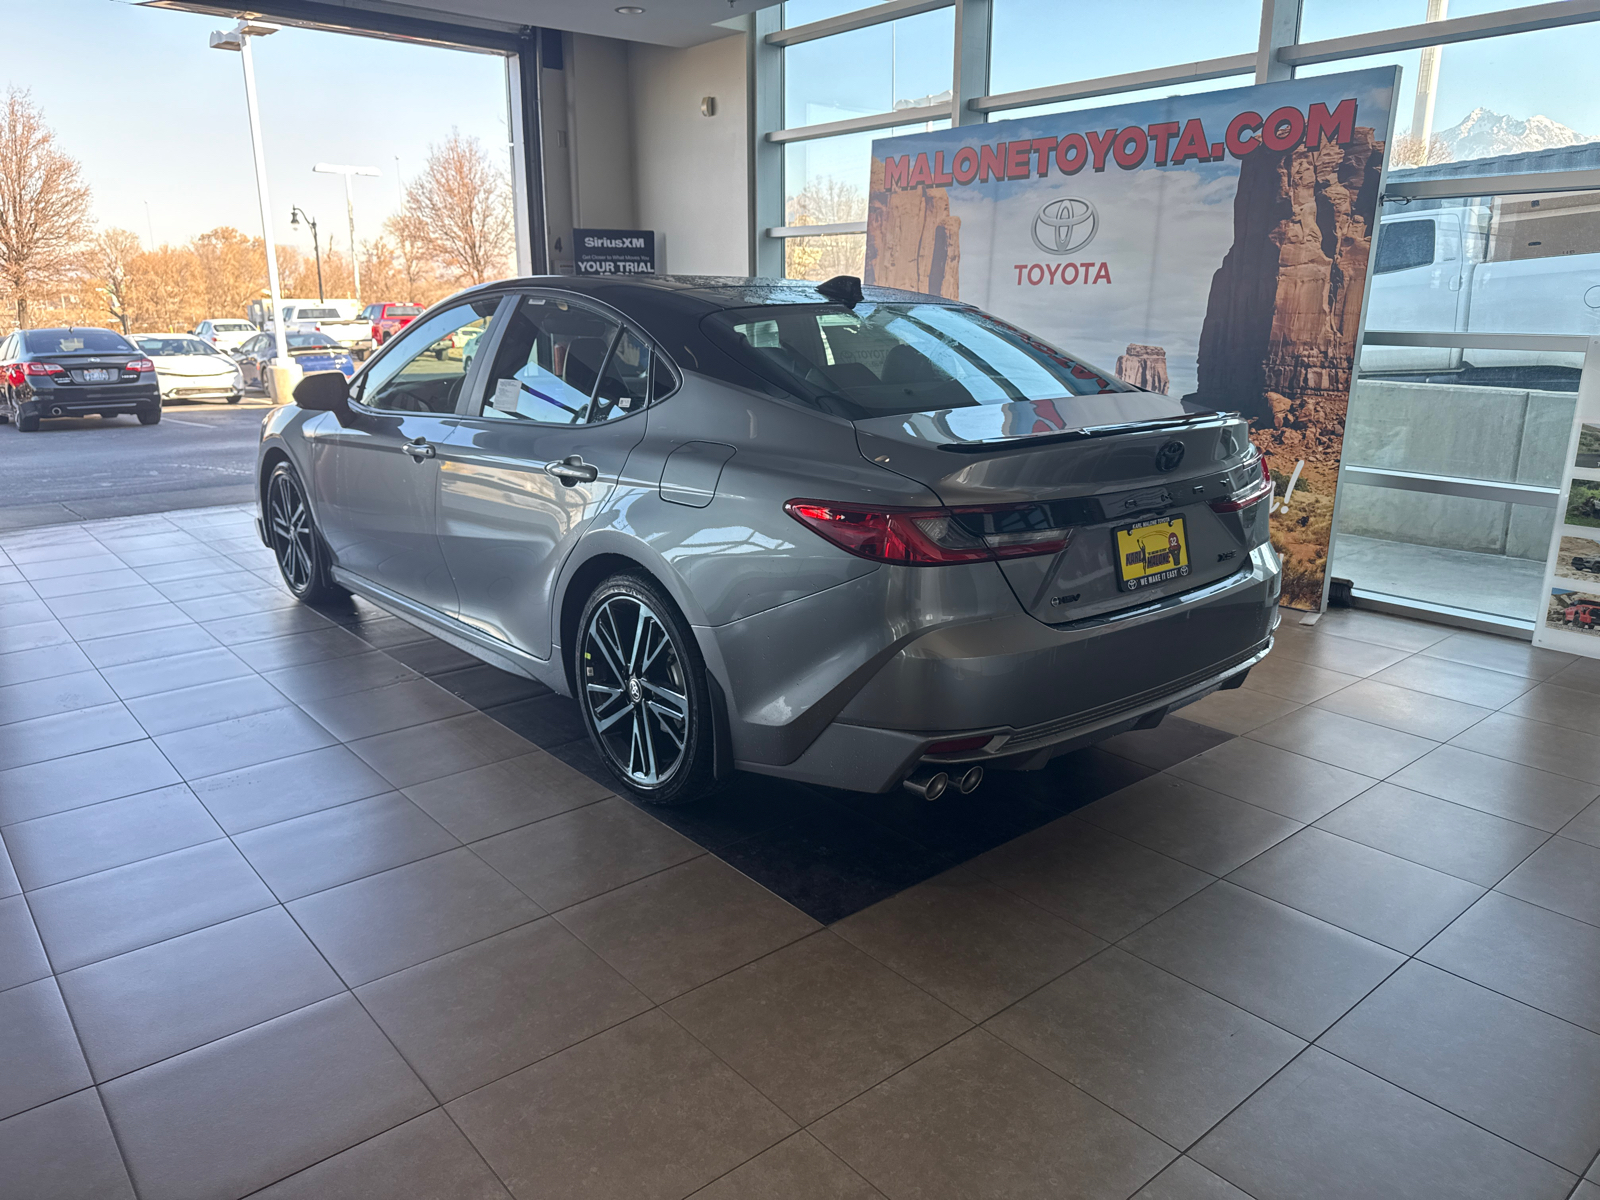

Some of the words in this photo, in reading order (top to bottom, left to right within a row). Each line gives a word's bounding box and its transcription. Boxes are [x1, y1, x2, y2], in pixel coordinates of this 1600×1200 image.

[884, 98, 1357, 192] MALONETOYOTA.COM
[554, 236, 562, 253] 4
[584, 237, 645, 248] SiriusXM
[578, 261, 615, 272] YOUR
[616, 262, 655, 273] TRIAL
[1013, 261, 1112, 286] TOYOTA
[1142, 519, 1157, 528] MALONE
[1157, 517, 1170, 525] TOYOTA
[1169, 536, 1177, 546] 32
[1146, 551, 1171, 569] MALONE
[1140, 577, 1148, 586] WE
[1148, 574, 1161, 584] MAKE
[1161, 572, 1167, 580] IT
[1166, 569, 1178, 579] EASY
